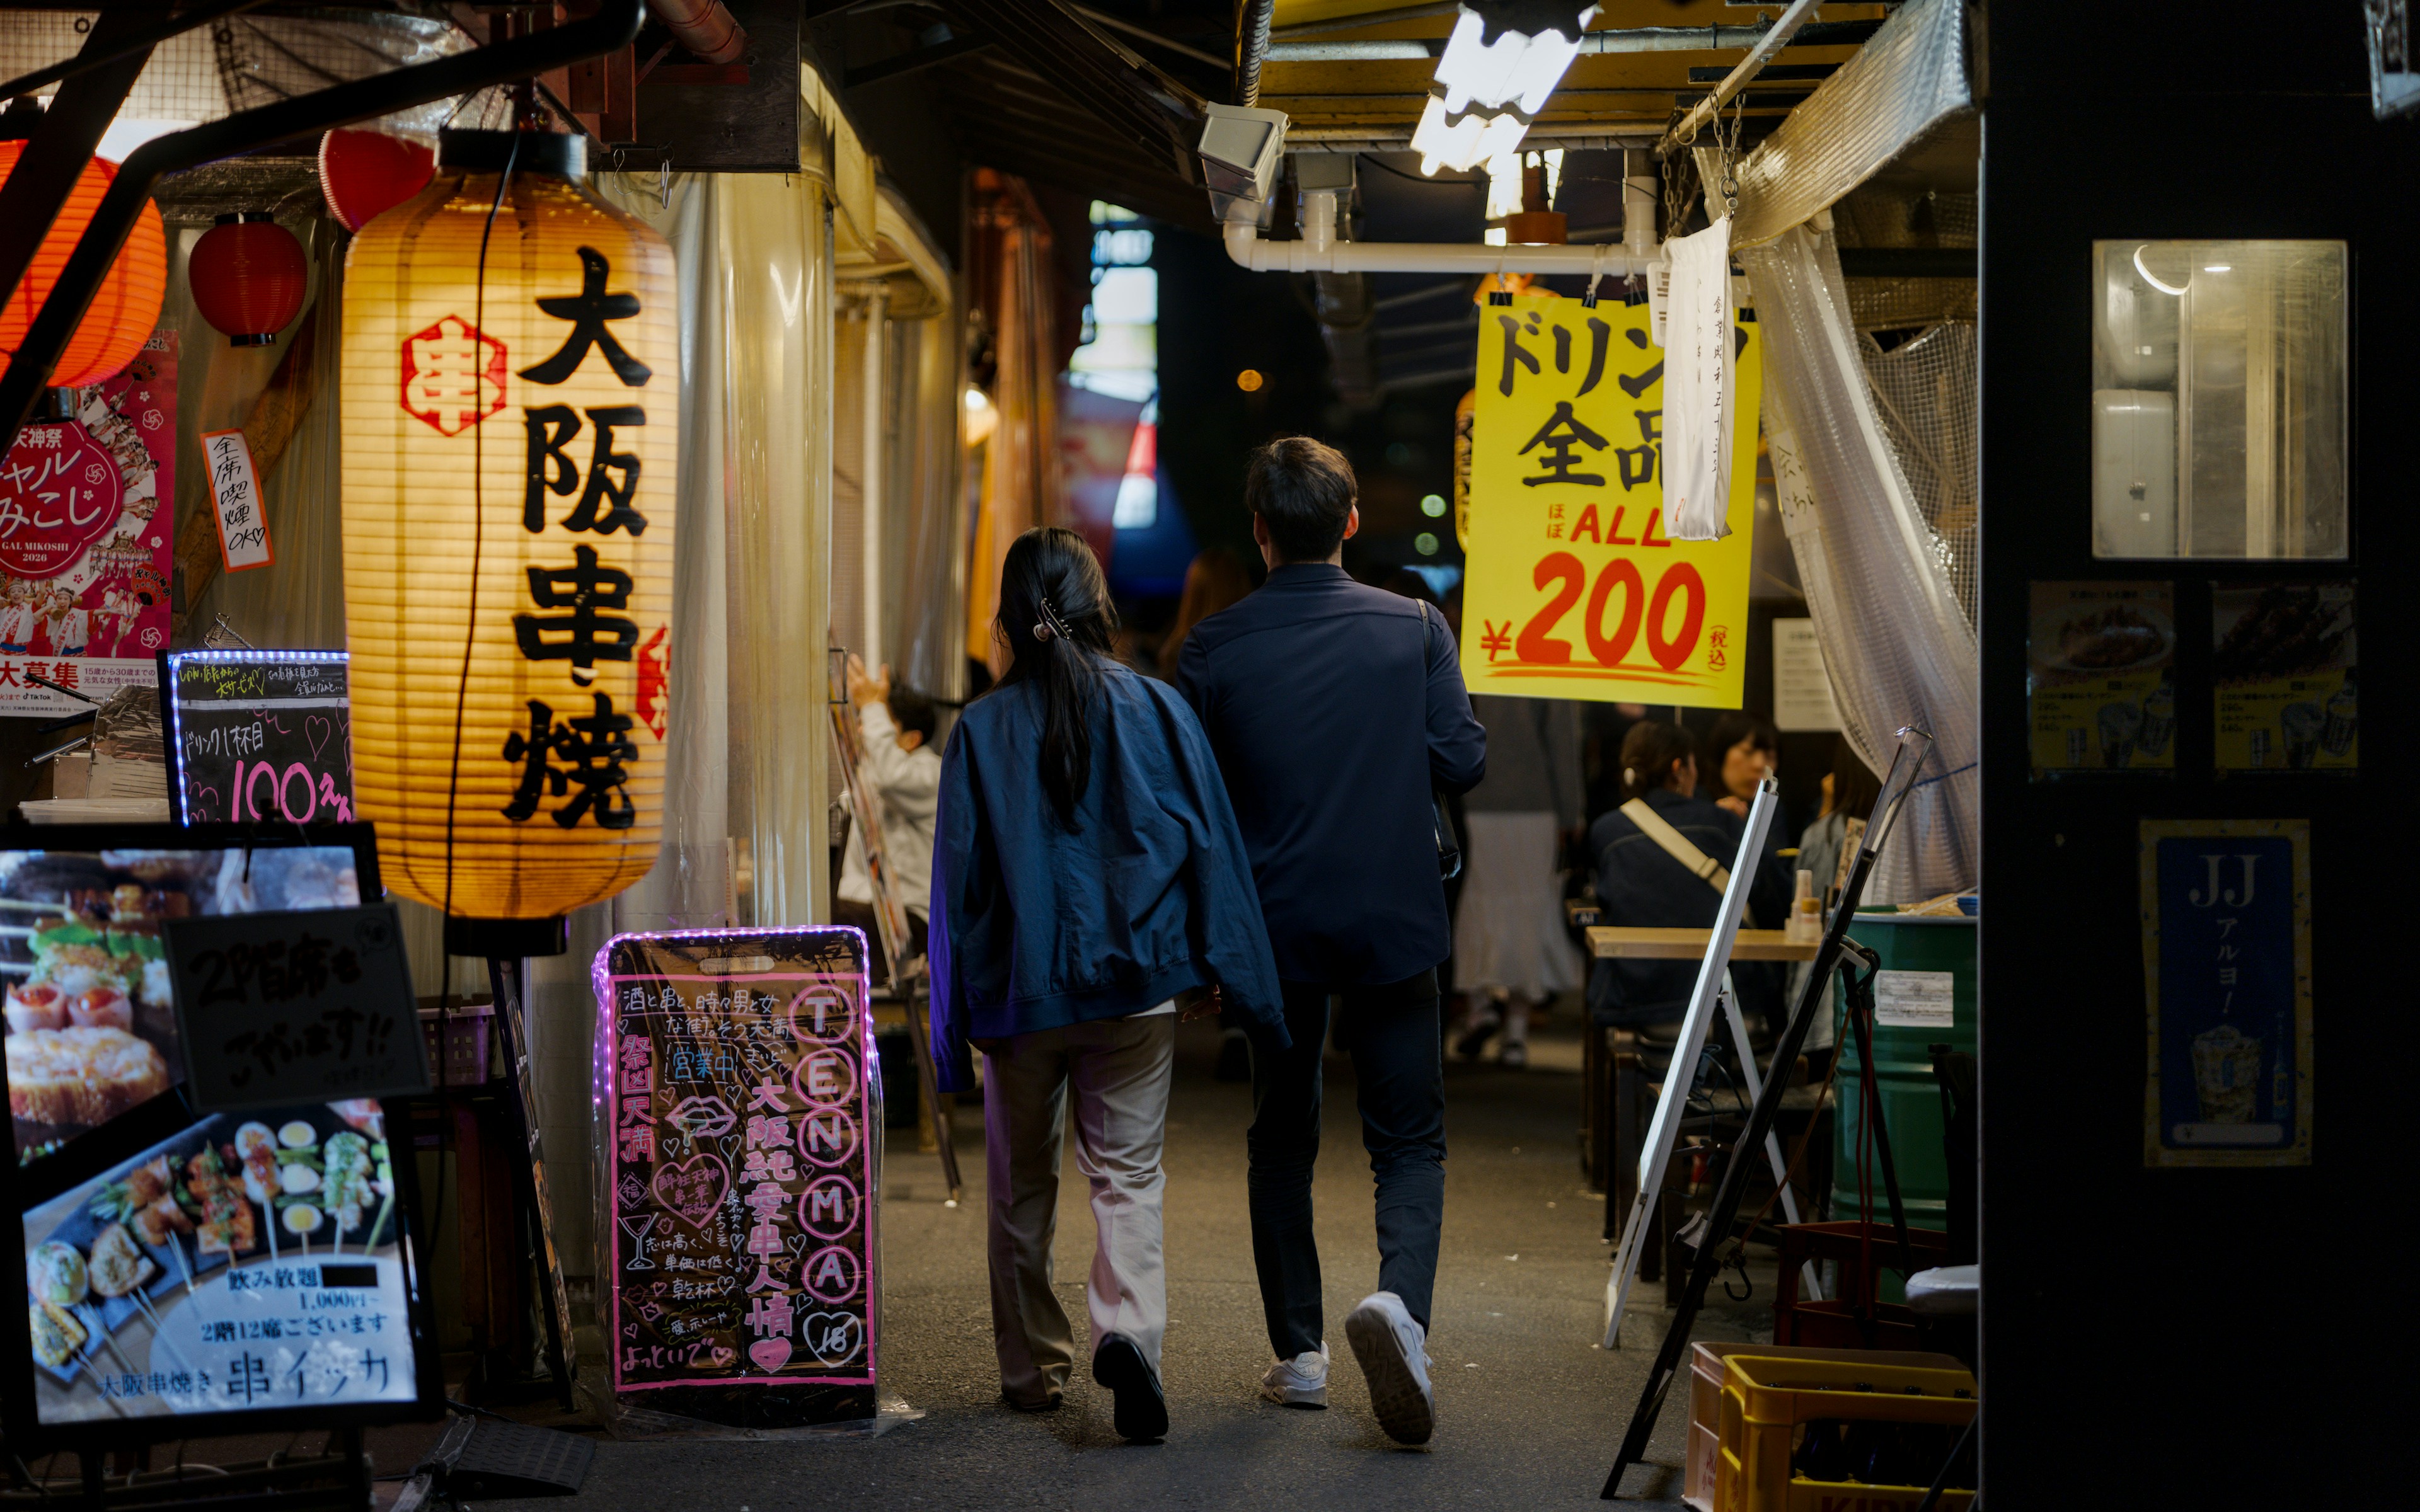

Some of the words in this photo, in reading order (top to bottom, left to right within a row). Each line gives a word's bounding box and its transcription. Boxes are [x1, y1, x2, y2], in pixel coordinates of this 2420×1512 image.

[1496, 311, 1748, 399] ドリン
[406, 316, 503, 433] 串
[15, 428, 62, 449] 天神祭
[1518, 399, 1665, 491] 全品
[0, 486, 101, 539] みこし
[1570, 503, 1672, 547] ALL
[1, 542, 23, 550] GAL
[25, 542, 69, 551] MIKOSHI
[502, 246, 652, 830] 大阪串焼
[23, 553, 48, 562] 2026
[1480, 551, 1705, 672] ¥200
[1708, 625, 1727, 672] (税込)
[0, 661, 79, 689] 大募集
[84, 668, 156, 676] 15歳から30歳までの
[2189, 854, 2264, 907] JJ
[623, 985, 780, 1014] 酒と串と、時々男と女
[672, 1046, 735, 1079] 営業中
[744, 1048, 787, 1064] まいど
[739, 1076, 796, 1337] 大阪純愛串人情
[228, 1266, 318, 1290] 飲み放題
[672, 1277, 717, 1300] 乾杯
[200, 1313, 388, 1343] 2階12席ございます
[98, 1371, 211, 1400] 大阪串焼き
[226, 1349, 389, 1406] 串イッカ
